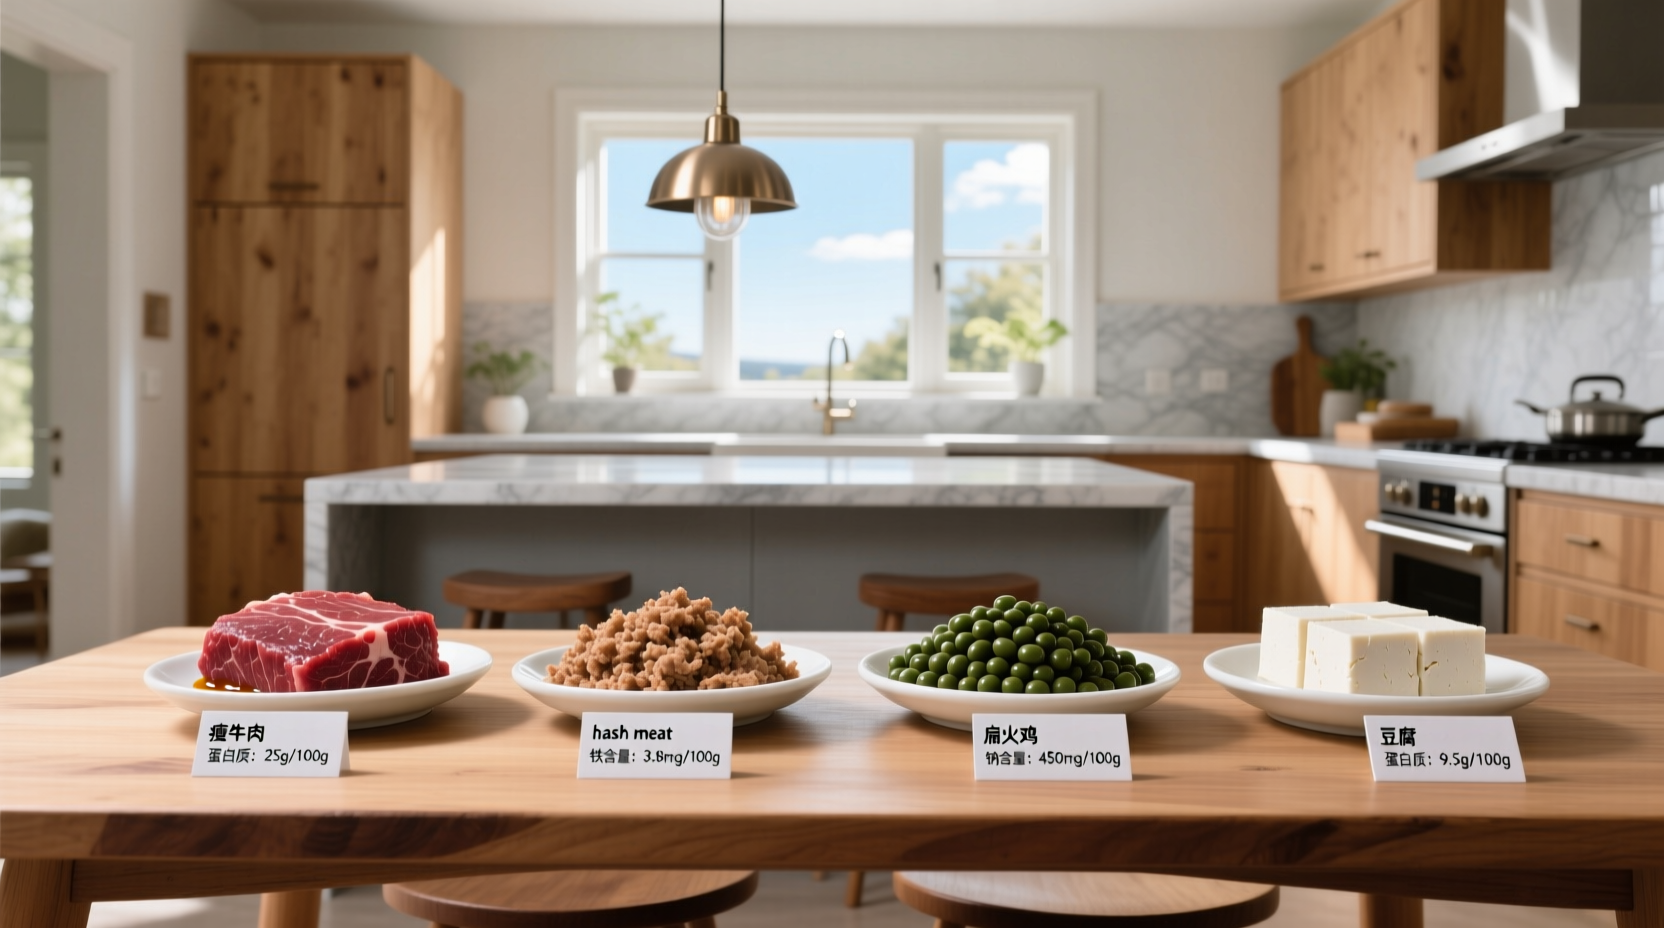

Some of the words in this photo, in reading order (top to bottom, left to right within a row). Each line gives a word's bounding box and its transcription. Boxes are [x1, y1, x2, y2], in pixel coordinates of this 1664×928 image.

[592, 724, 629, 740] hash
[633, 726, 674, 740] meat
[1380, 726, 1417, 747] 豆腐
